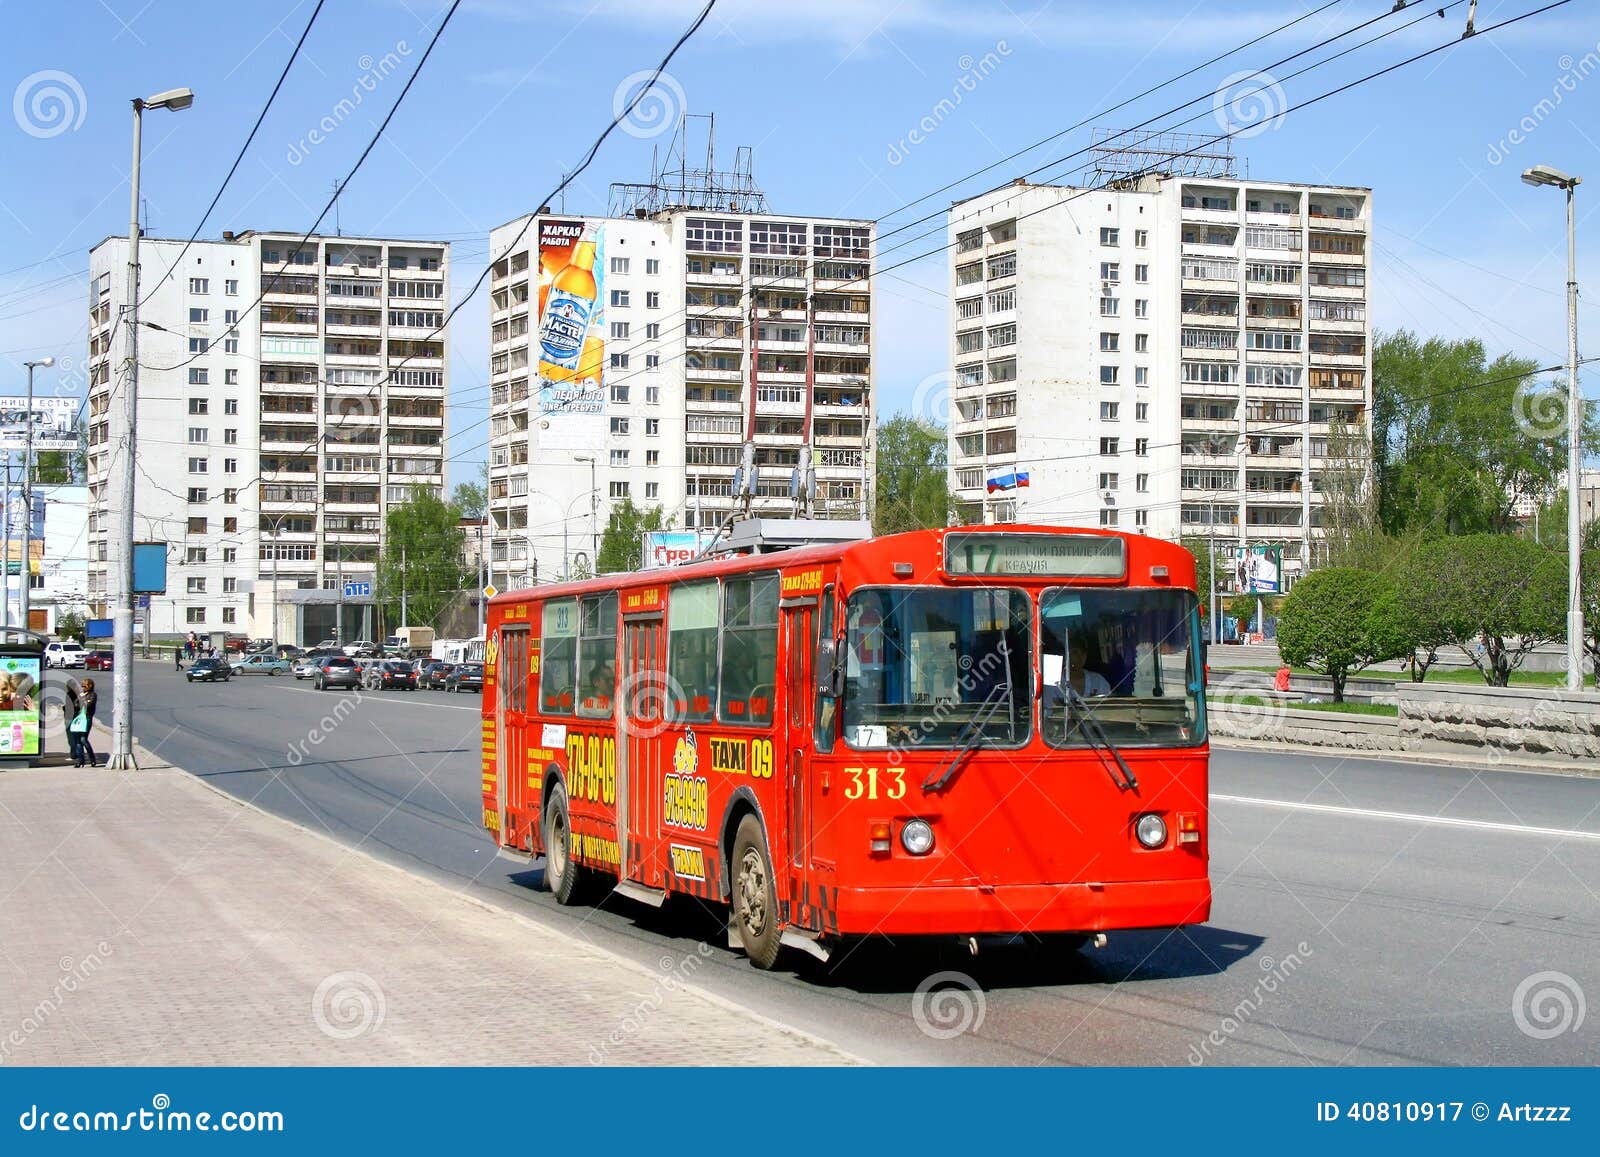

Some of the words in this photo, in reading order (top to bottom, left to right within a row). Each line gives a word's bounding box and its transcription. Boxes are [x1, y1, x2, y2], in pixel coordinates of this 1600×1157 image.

[540, 237, 570, 246] РАБОТА
[542, 225, 582, 237] ЖАРКАЯ
[552, 390, 604, 401] ЛЕДЯНОГО
[964, 544, 999, 572] 17
[556, 607, 570, 628] 313
[566, 732, 617, 805] 379-09-09
[710, 738, 747, 774] TAXI
[751, 738, 773, 779] 09
[844, 767, 907, 800] 313
[665, 774, 707, 831] 379-09-09
[671, 845, 705, 880] TAXI
